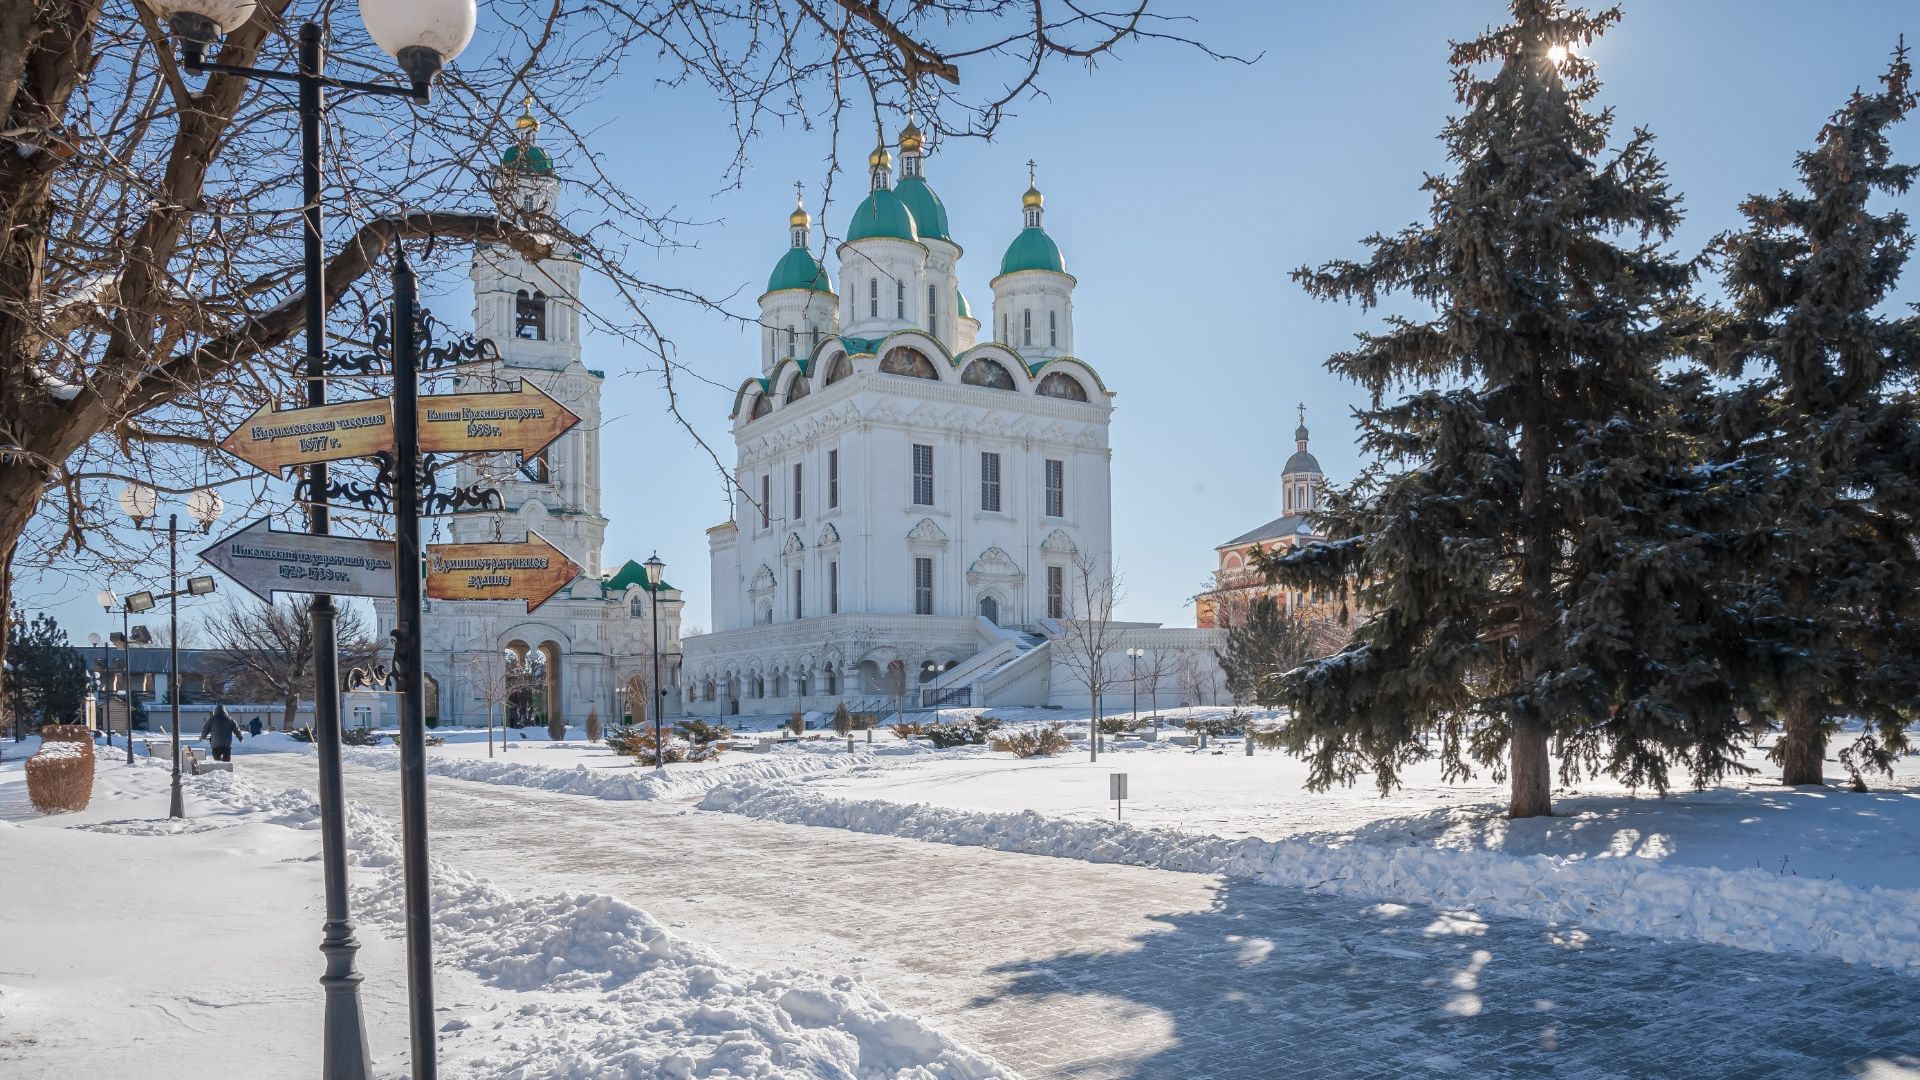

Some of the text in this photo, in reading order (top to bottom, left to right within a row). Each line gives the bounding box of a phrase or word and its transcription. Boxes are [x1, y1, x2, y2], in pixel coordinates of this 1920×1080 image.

[336, 414, 385, 430] часовня
[427, 407, 544, 424] Башня Красные ворота
[467, 424, 491, 437] 1958
[300, 436, 341, 452] 1677 г.
[231, 544, 298, 561] Никольский
[364, 557, 392, 570] храм
[468, 575, 511, 589] здание
